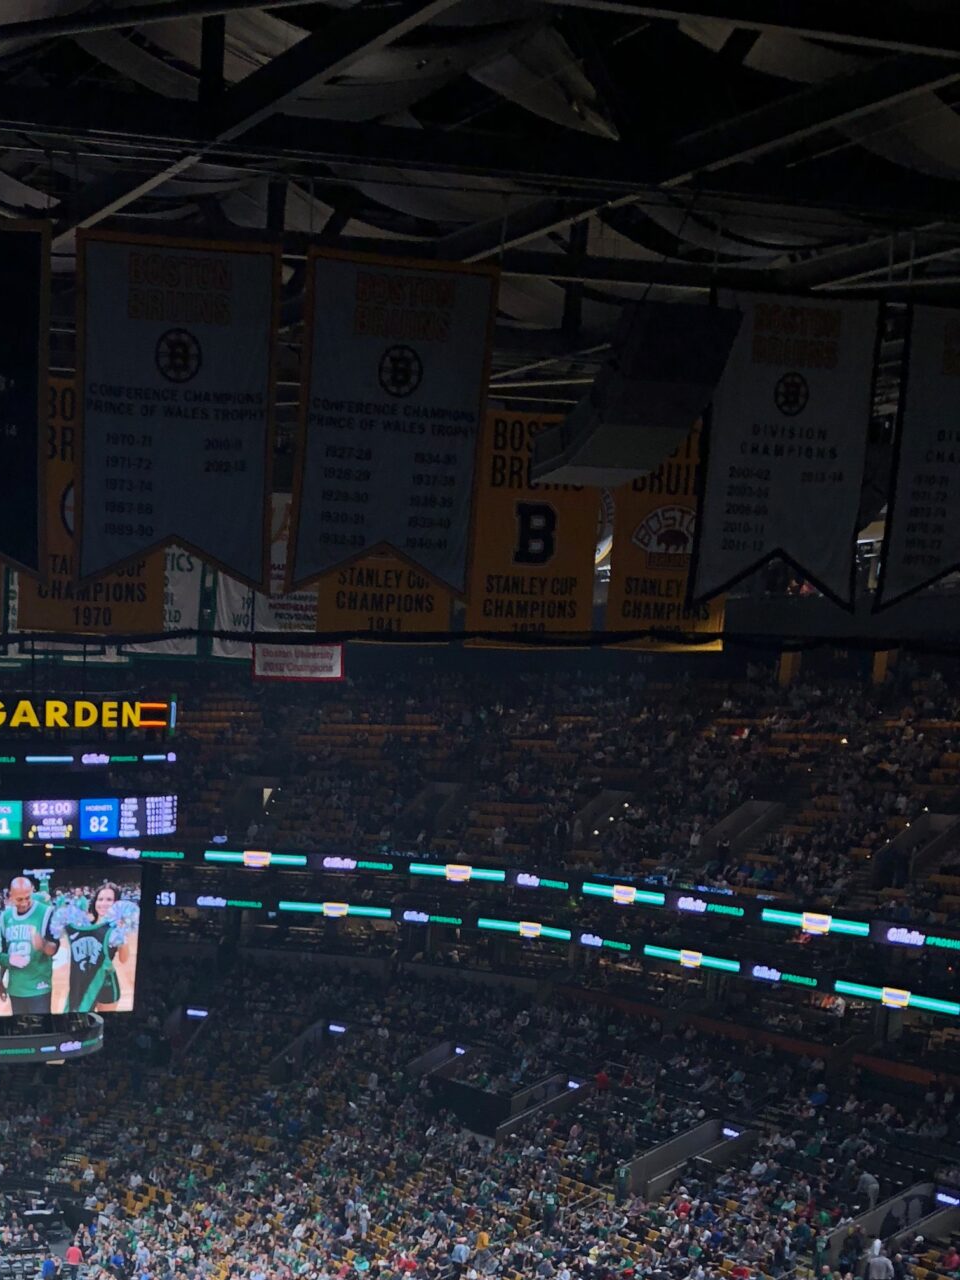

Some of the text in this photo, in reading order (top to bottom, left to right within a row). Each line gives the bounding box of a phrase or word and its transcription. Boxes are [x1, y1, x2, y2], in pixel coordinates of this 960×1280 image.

[90, 383, 179, 402] CONFERENCE
[86, 399, 135, 417] PRINCE
[140, 402, 157, 419] OF
[163, 404, 209, 421] WALES
[313, 398, 399, 416] CONFERENCE
[309, 413, 356, 430] PRINCE
[360, 416, 375, 431] OF
[382, 417, 426, 434] WALES
[752, 423, 828, 441] DIVISION
[740, 443, 838, 459] CHAMPIONS
[514, 502, 557, 563] B
[338, 567, 404, 588] STANLEY
[486, 575, 577, 597] STANLEY CUP
[625, 576, 683, 597] STANLEY
[336, 590, 434, 613] CHAMPIONS
[482, 598, 577, 619] CHAMPIONS
[73, 605, 113, 627] 1970
[32, 802, 72, 816] 12:00
[90, 816, 109, 834] 82
[155, 891, 176, 907] :51
